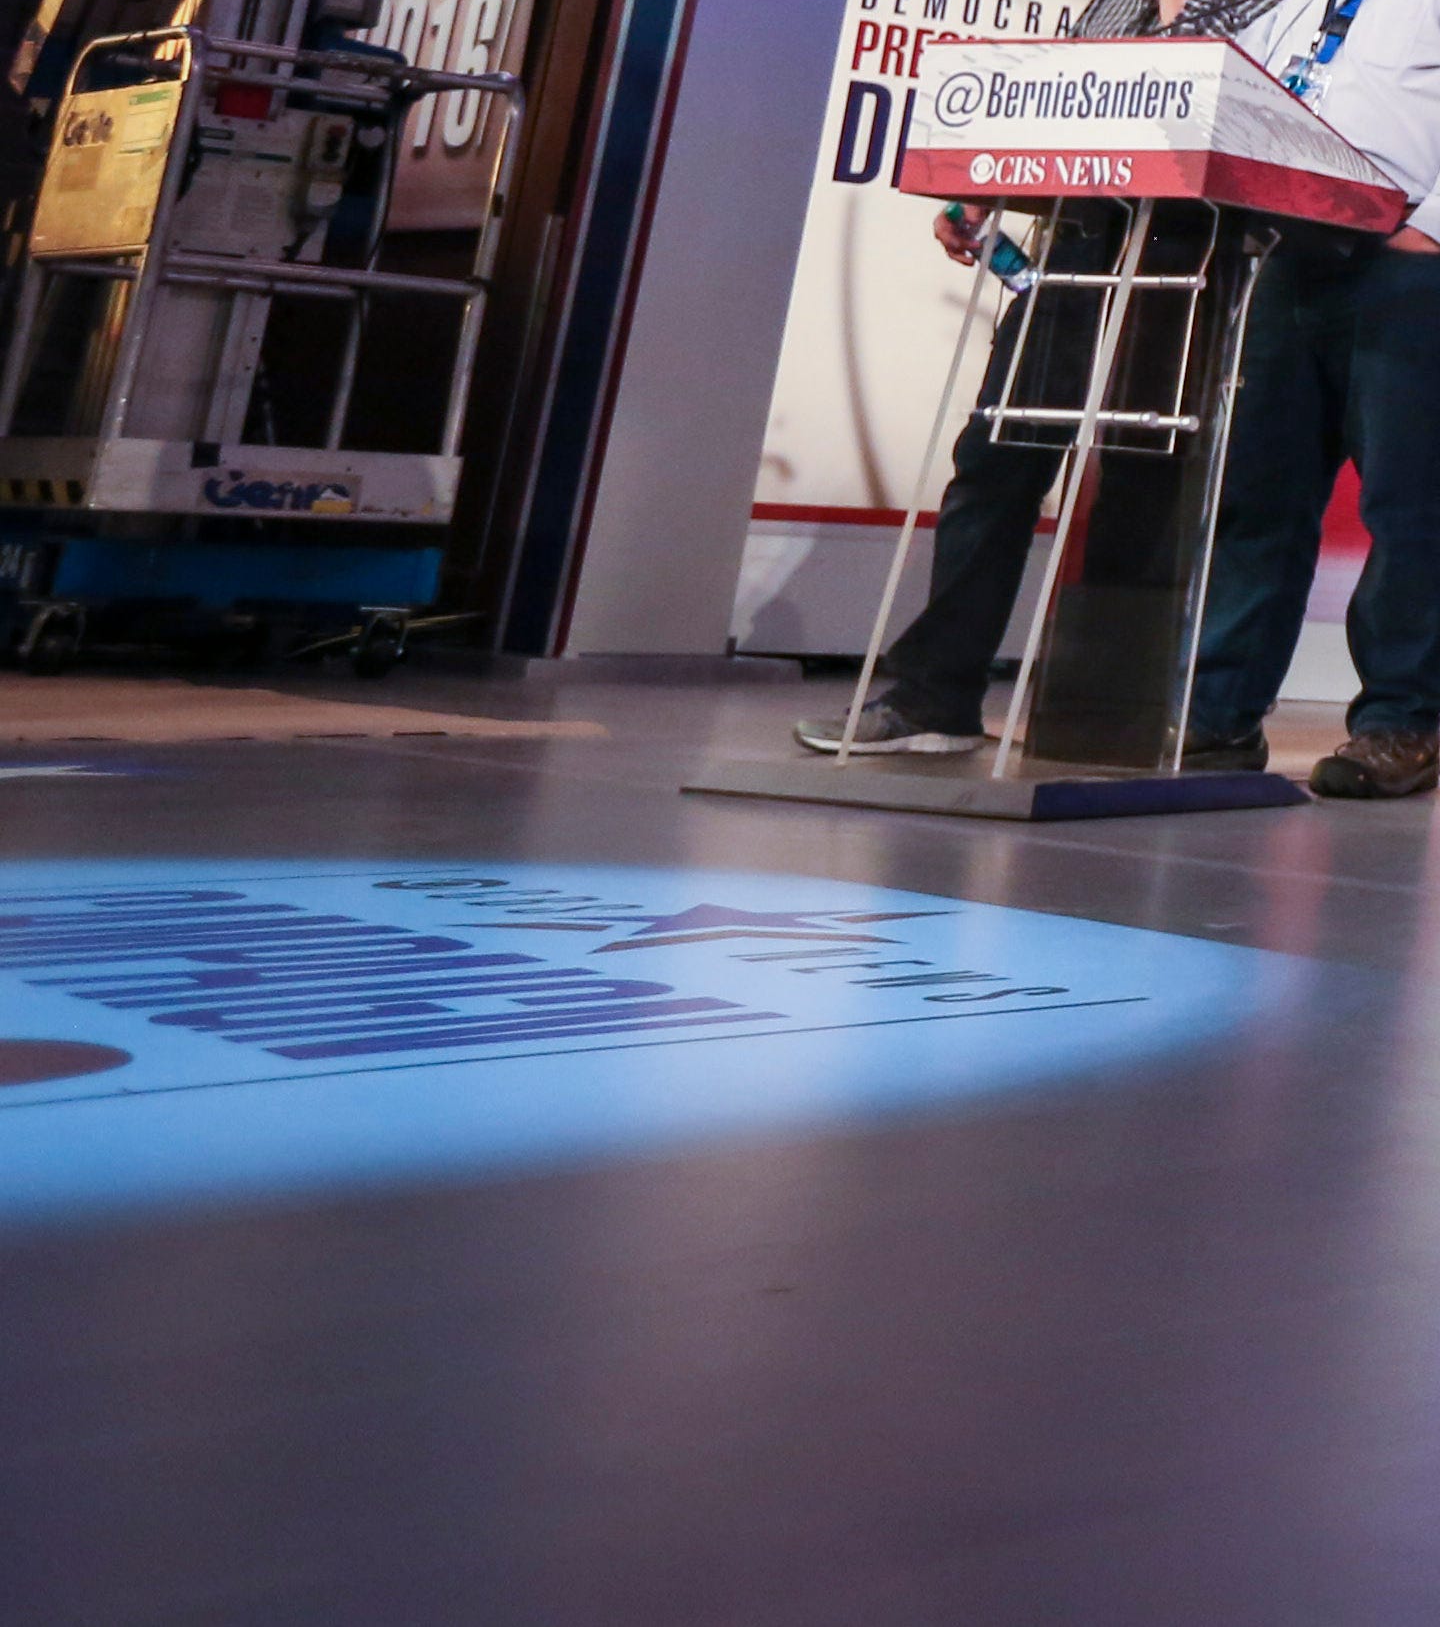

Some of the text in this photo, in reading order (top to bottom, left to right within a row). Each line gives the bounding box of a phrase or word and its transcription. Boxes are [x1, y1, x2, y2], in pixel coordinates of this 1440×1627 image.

[935, 72, 1194, 128] @BernieSanders
[995, 154, 1133, 186] CBS NEWS
